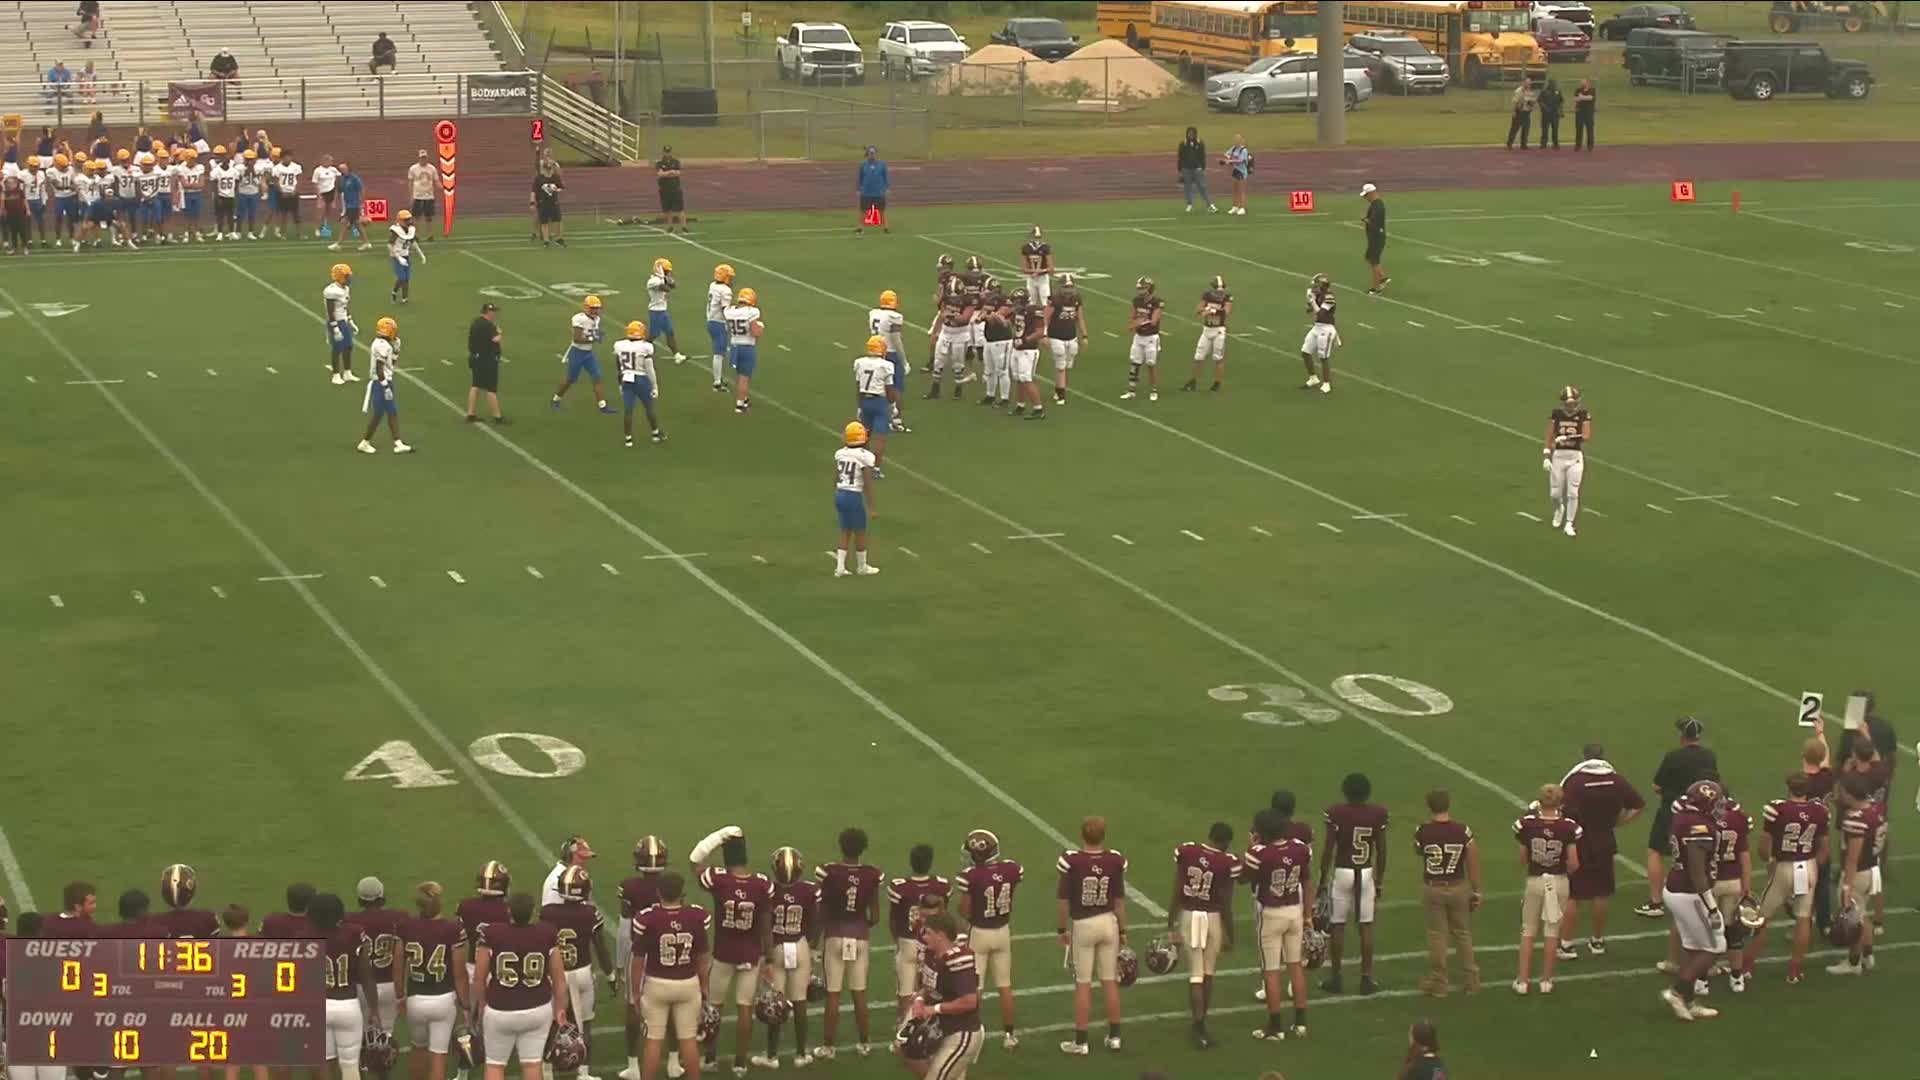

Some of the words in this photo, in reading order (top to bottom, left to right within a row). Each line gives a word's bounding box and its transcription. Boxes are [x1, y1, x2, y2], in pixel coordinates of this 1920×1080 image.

[471, 87, 527, 98] BODYARMOR
[281, 174, 294, 186] 78
[1680, 184, 1689, 196] G
[368, 201, 385, 215] 30
[1294, 193, 1310, 206] 10
[864, 370, 875, 391] 7
[1207, 674, 1454, 726] 30
[1801, 696, 1821, 724] 2
[344, 732, 586, 788] 40
[1700, 784, 1717, 800] GC
[1351, 827, 1373, 866] 5
[1781, 822, 1818, 854] 24
[1423, 843, 1464, 876] 27
[1183, 865, 1215, 901] 31
[846, 886, 858, 912] 1
[983, 882, 1012, 918] 14
[722, 900, 756, 931] 13
[405, 942, 447, 983] 24
[659, 932, 694, 966] 67
[496, 951, 545, 988] 69
